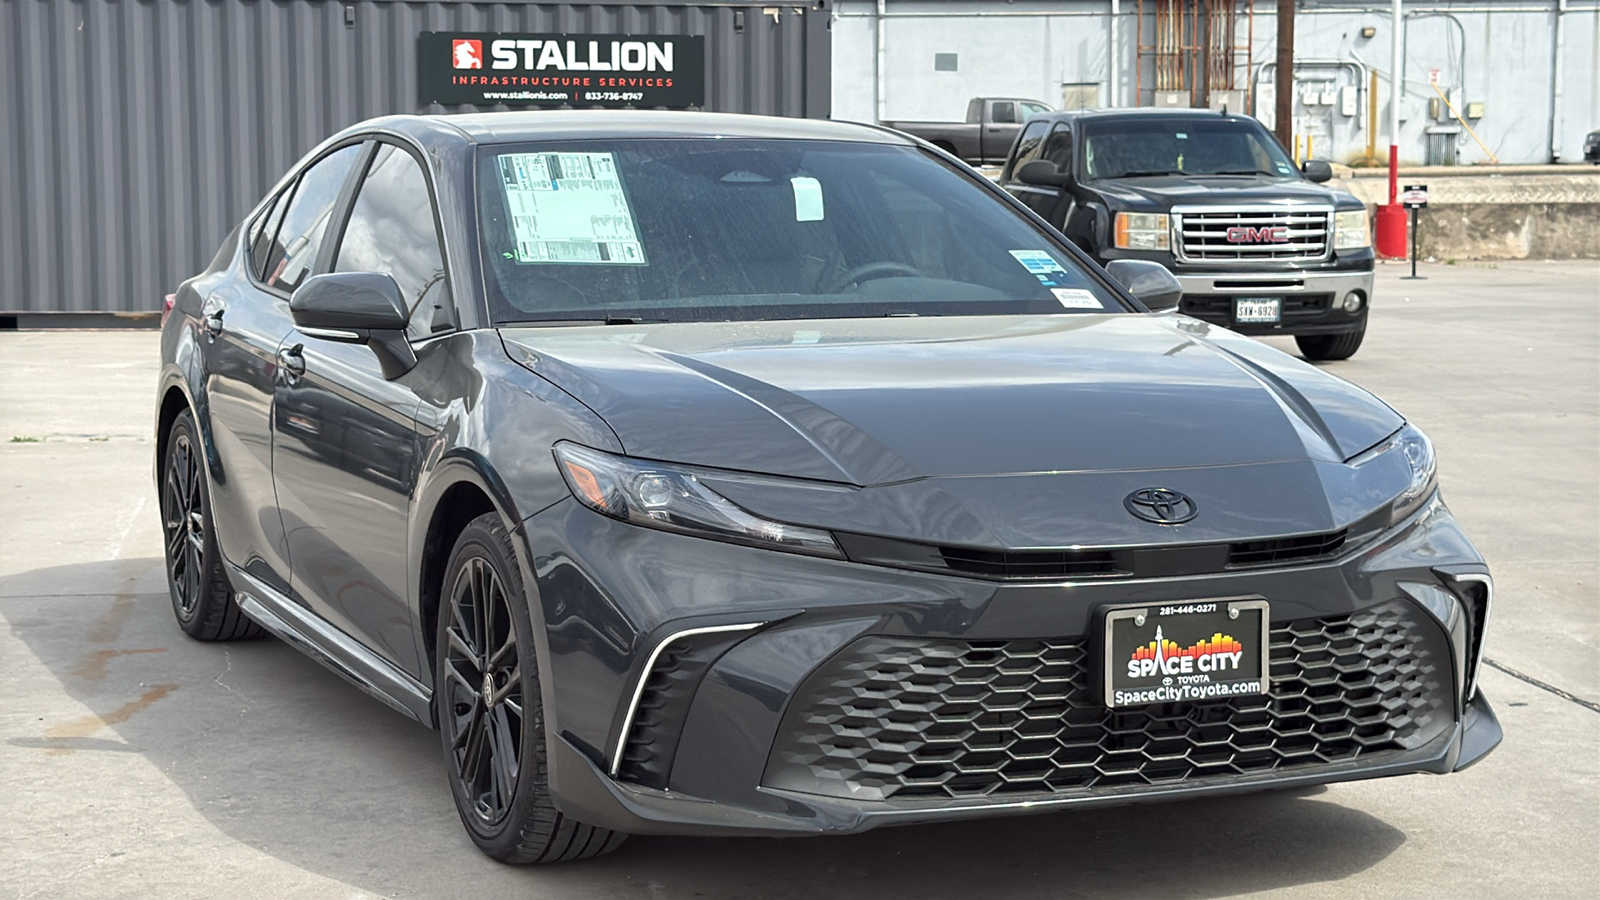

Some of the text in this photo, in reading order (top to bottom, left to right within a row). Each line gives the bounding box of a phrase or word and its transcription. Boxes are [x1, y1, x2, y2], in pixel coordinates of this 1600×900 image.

[491, 39, 674, 72] STALLION
[452, 75, 674, 88] INFRASTRUCTURE SERVICES
[483, 91, 568, 100] www.stallionis.com
[1226, 226, 1289, 243] GMC
[1127, 651, 1243, 678] SPACE CITY
[1177, 674, 1210, 685] TOYOTA
[1115, 681, 1260, 706] SpaceCityToyota.com
